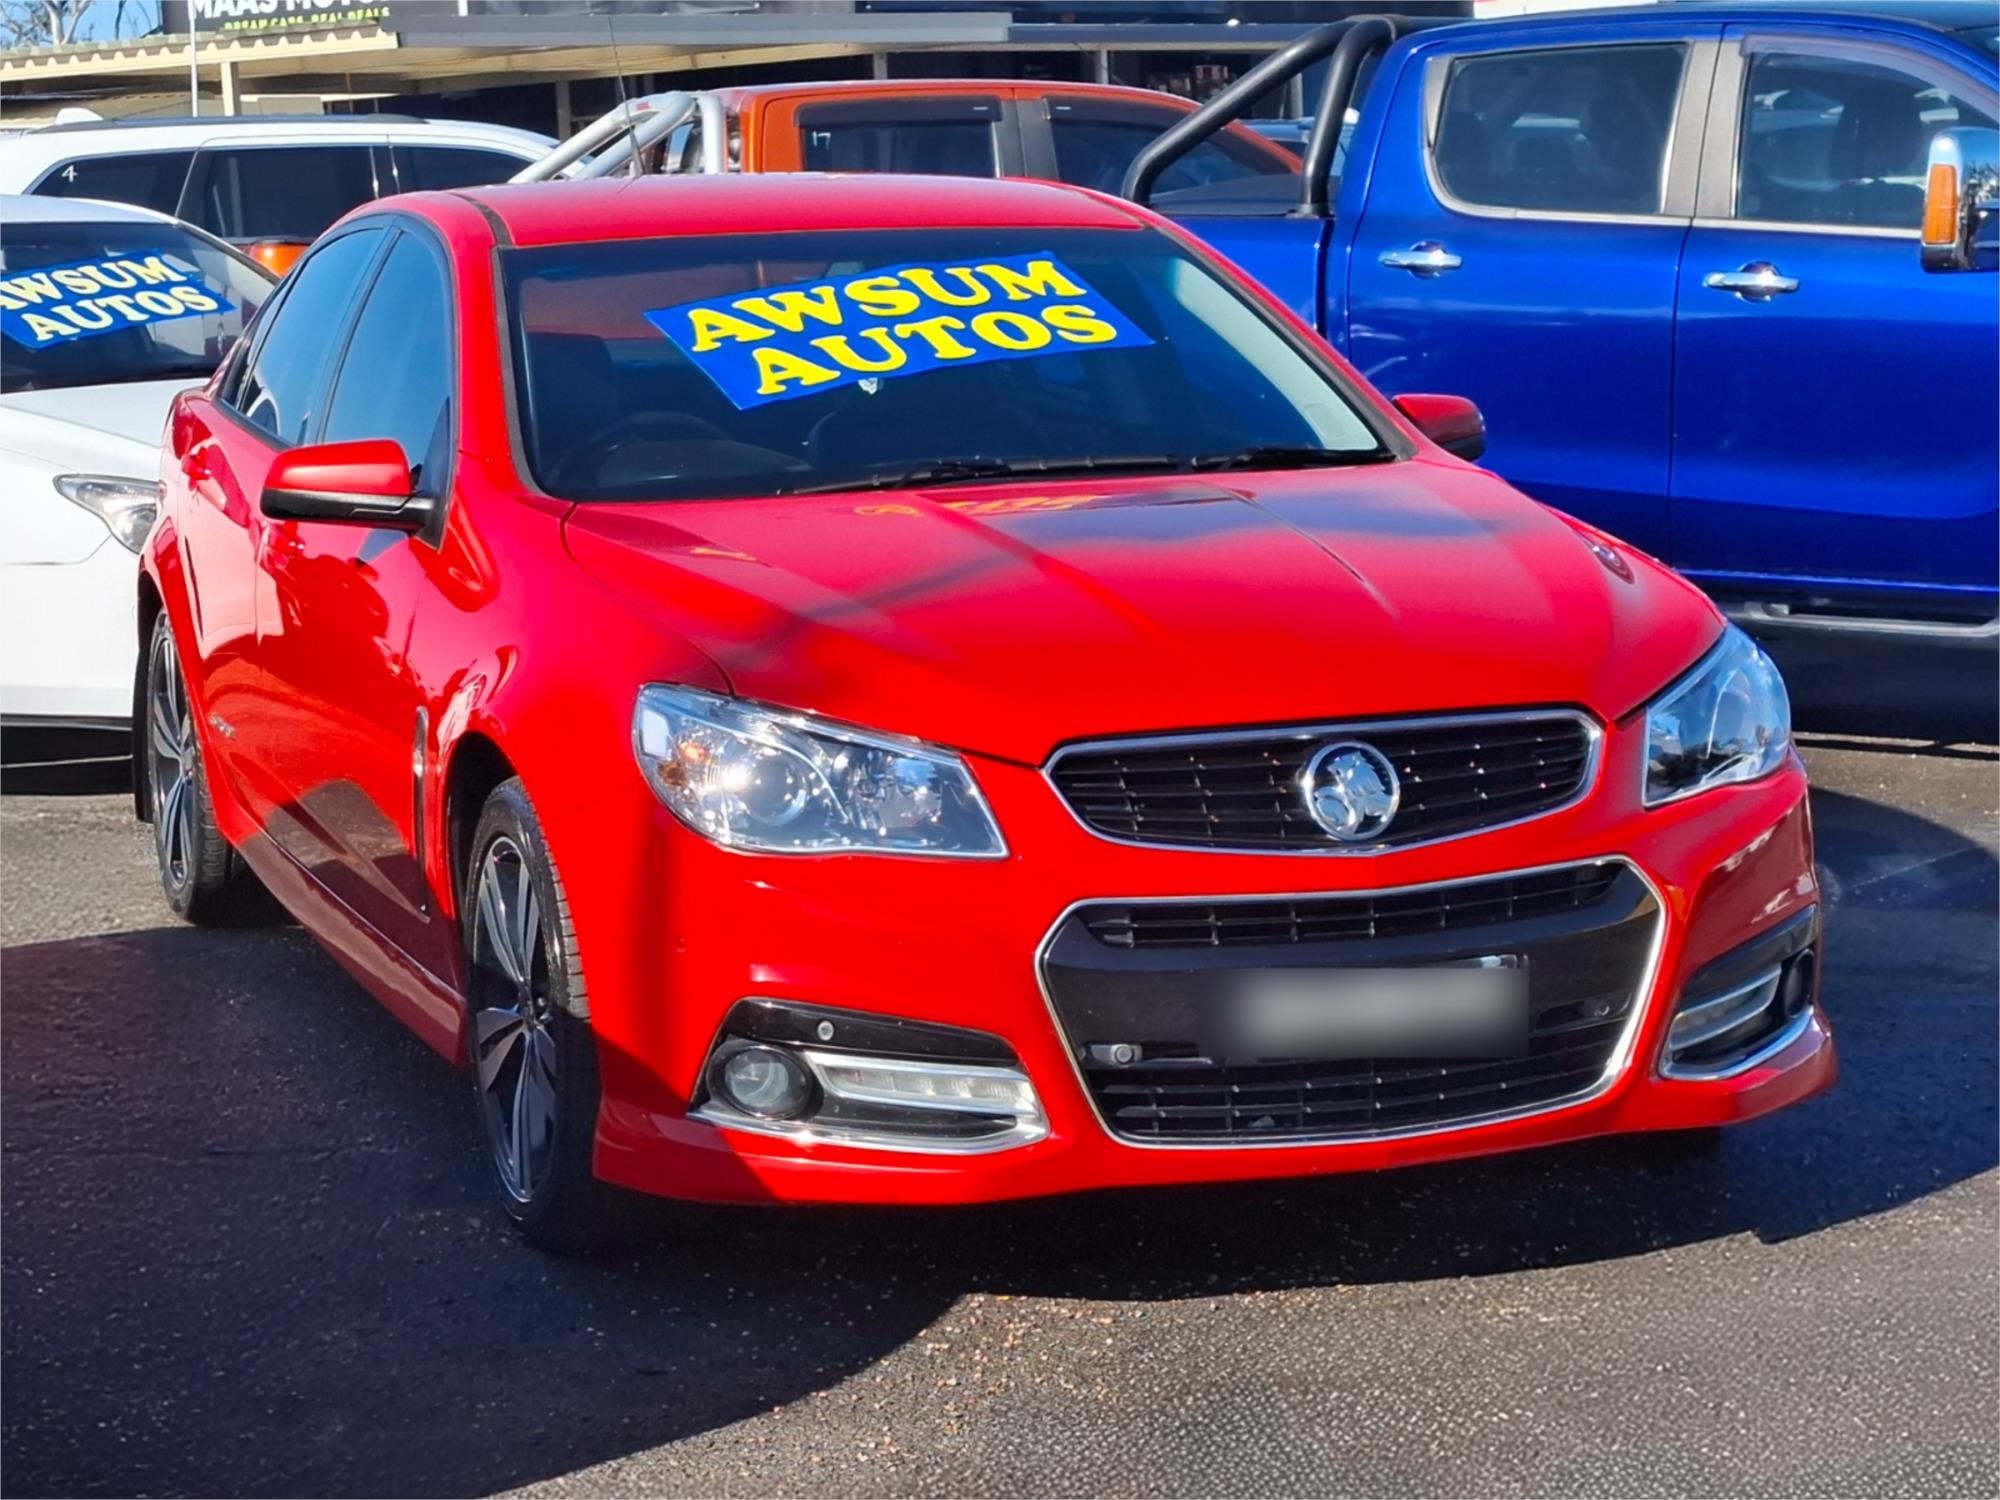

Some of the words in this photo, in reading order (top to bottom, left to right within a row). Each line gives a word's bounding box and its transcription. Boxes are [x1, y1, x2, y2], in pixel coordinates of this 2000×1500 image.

[812, 130, 831, 151] 17
[61, 165, 78, 182] 4
[21, 286, 218, 341] AUTOS
[688, 261, 1086, 352] AWSUM
[752, 305, 1117, 395] AUTOS
